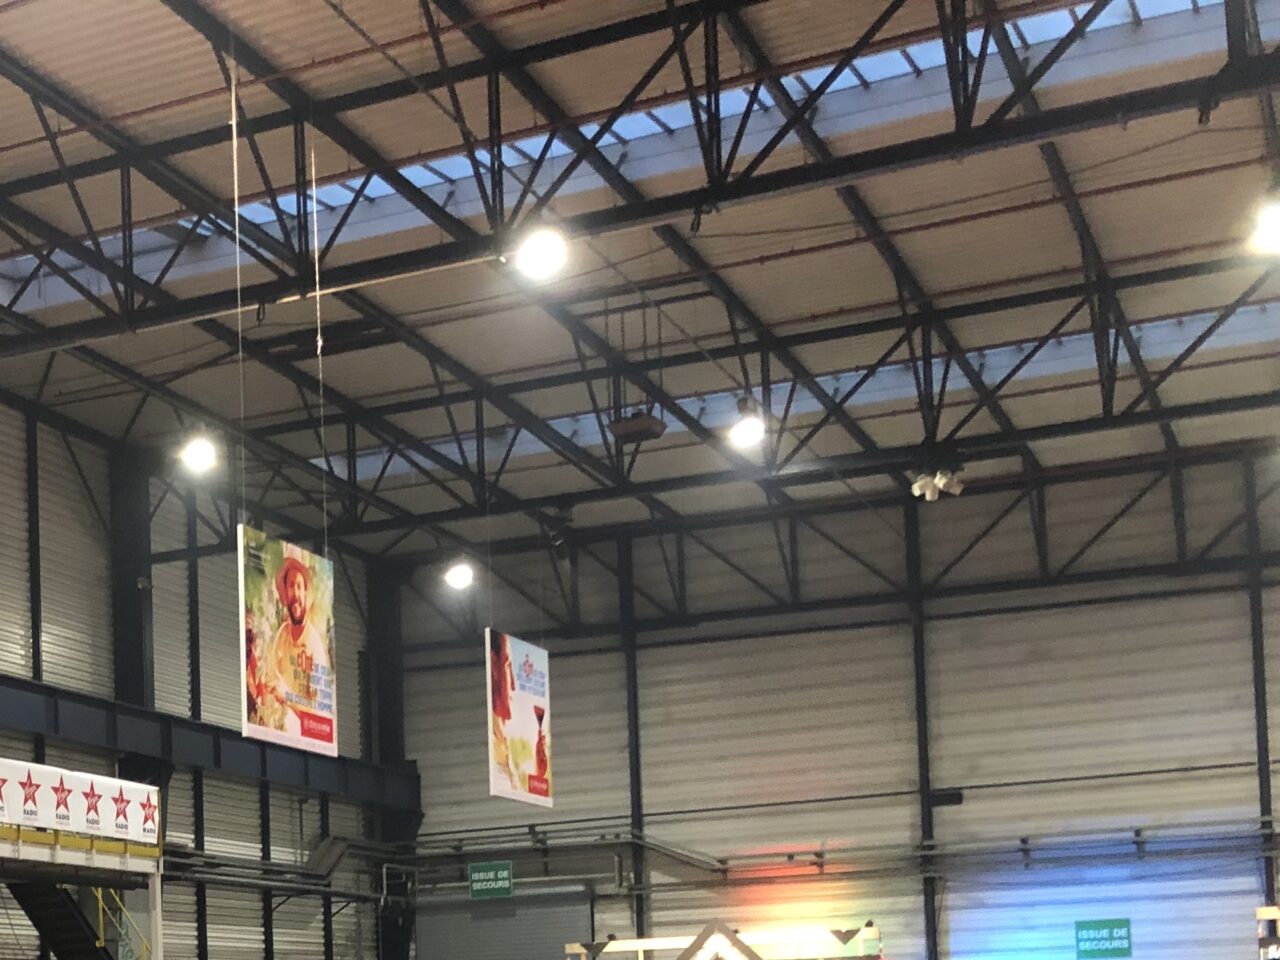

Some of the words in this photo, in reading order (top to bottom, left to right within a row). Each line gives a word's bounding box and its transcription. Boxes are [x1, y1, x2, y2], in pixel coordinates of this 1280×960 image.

[472, 871, 495, 880] ISSUE
[498, 870, 508, 879] DE
[472, 880, 509, 890] SECOURS
[1078, 929, 1109, 939] ISSUE
[1113, 928, 1128, 937] DE
[1079, 939, 1129, 950] SECOURS
